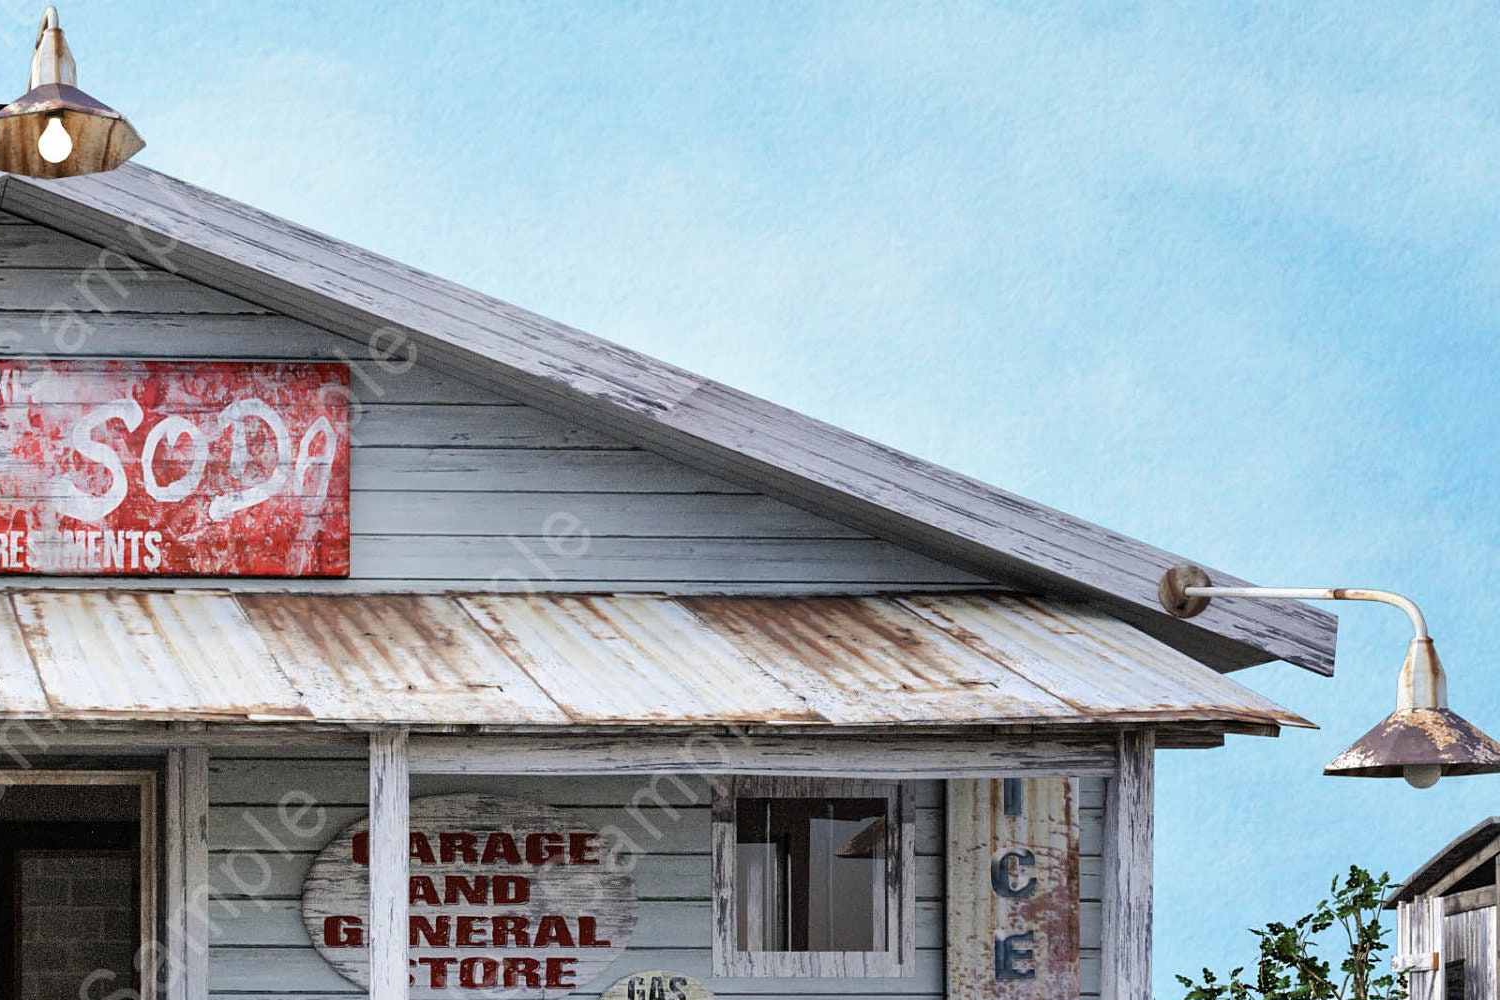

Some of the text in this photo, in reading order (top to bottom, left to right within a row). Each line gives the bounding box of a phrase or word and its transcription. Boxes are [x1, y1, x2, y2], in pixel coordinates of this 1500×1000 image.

[56, 398, 337, 522] SODA
[409, 875, 532, 907] AND
[323, 916, 611, 948] GNERAL
[410, 957, 579, 990] TORE
